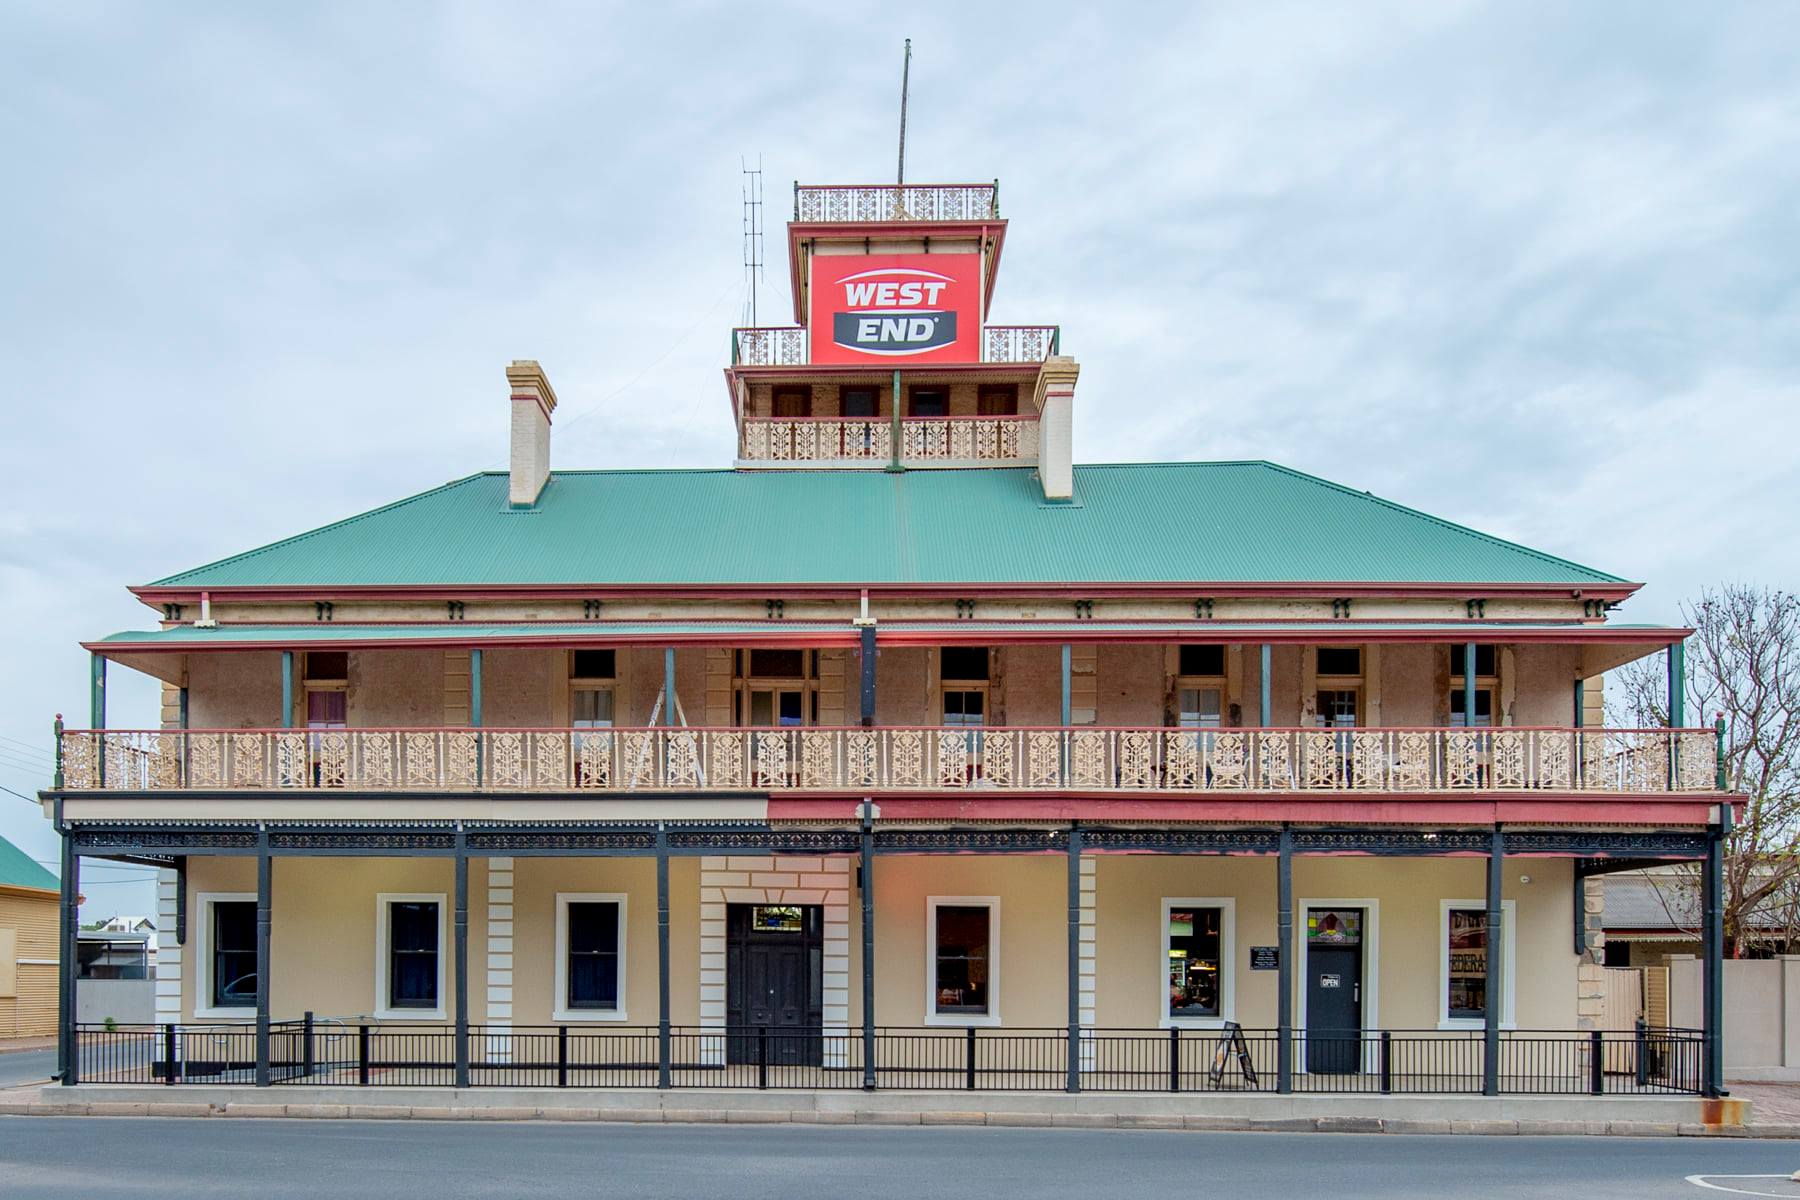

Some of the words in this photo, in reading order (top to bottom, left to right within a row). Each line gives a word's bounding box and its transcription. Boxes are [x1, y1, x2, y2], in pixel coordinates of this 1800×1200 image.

[845, 283, 946, 306] WEST
[857, 319, 934, 342] END
[1450, 953, 1488, 973] EDERA
[1322, 978, 1338, 987] OPEN
